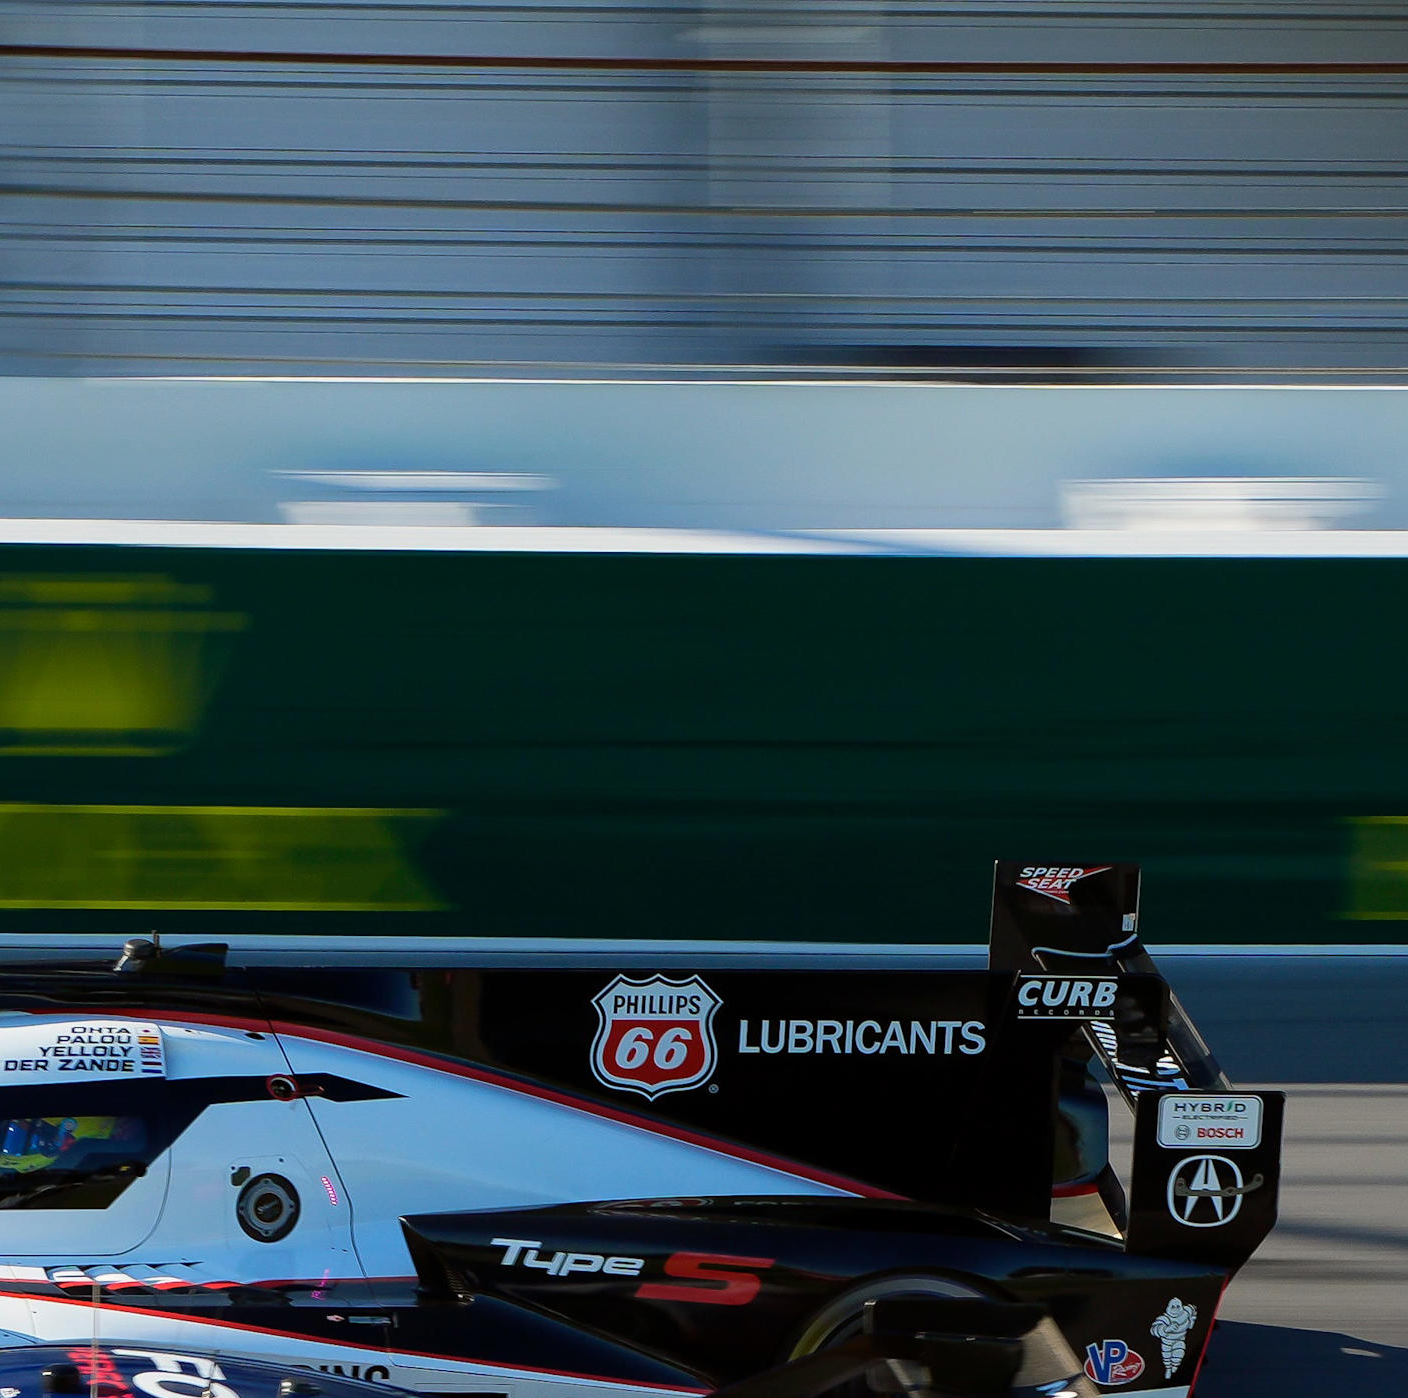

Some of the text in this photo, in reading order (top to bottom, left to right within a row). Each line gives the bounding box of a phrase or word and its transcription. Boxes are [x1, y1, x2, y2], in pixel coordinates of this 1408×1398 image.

[1019, 867, 1084, 878] SPEED
[1027, 878, 1078, 890] SEAT
[1017, 980, 1119, 1008] CURB
[613, 995, 701, 1015] PHILLIPS
[70, 1026, 131, 1034] OHTA
[56, 1035, 132, 1044] PALOU
[738, 1019, 986, 1055] LUBRICANTS
[38, 1046, 135, 1057] YELLOLY
[614, 1026, 693, 1070] 66
[4, 1059, 48, 1071] DER
[58, 1059, 135, 1072] ZANDE
[1173, 1100, 1247, 1113] HYBRID
[1196, 1127, 1244, 1139] BOSCH
[490, 1238, 777, 1306] Type S
[1085, 1339, 1129, 1384] VP
